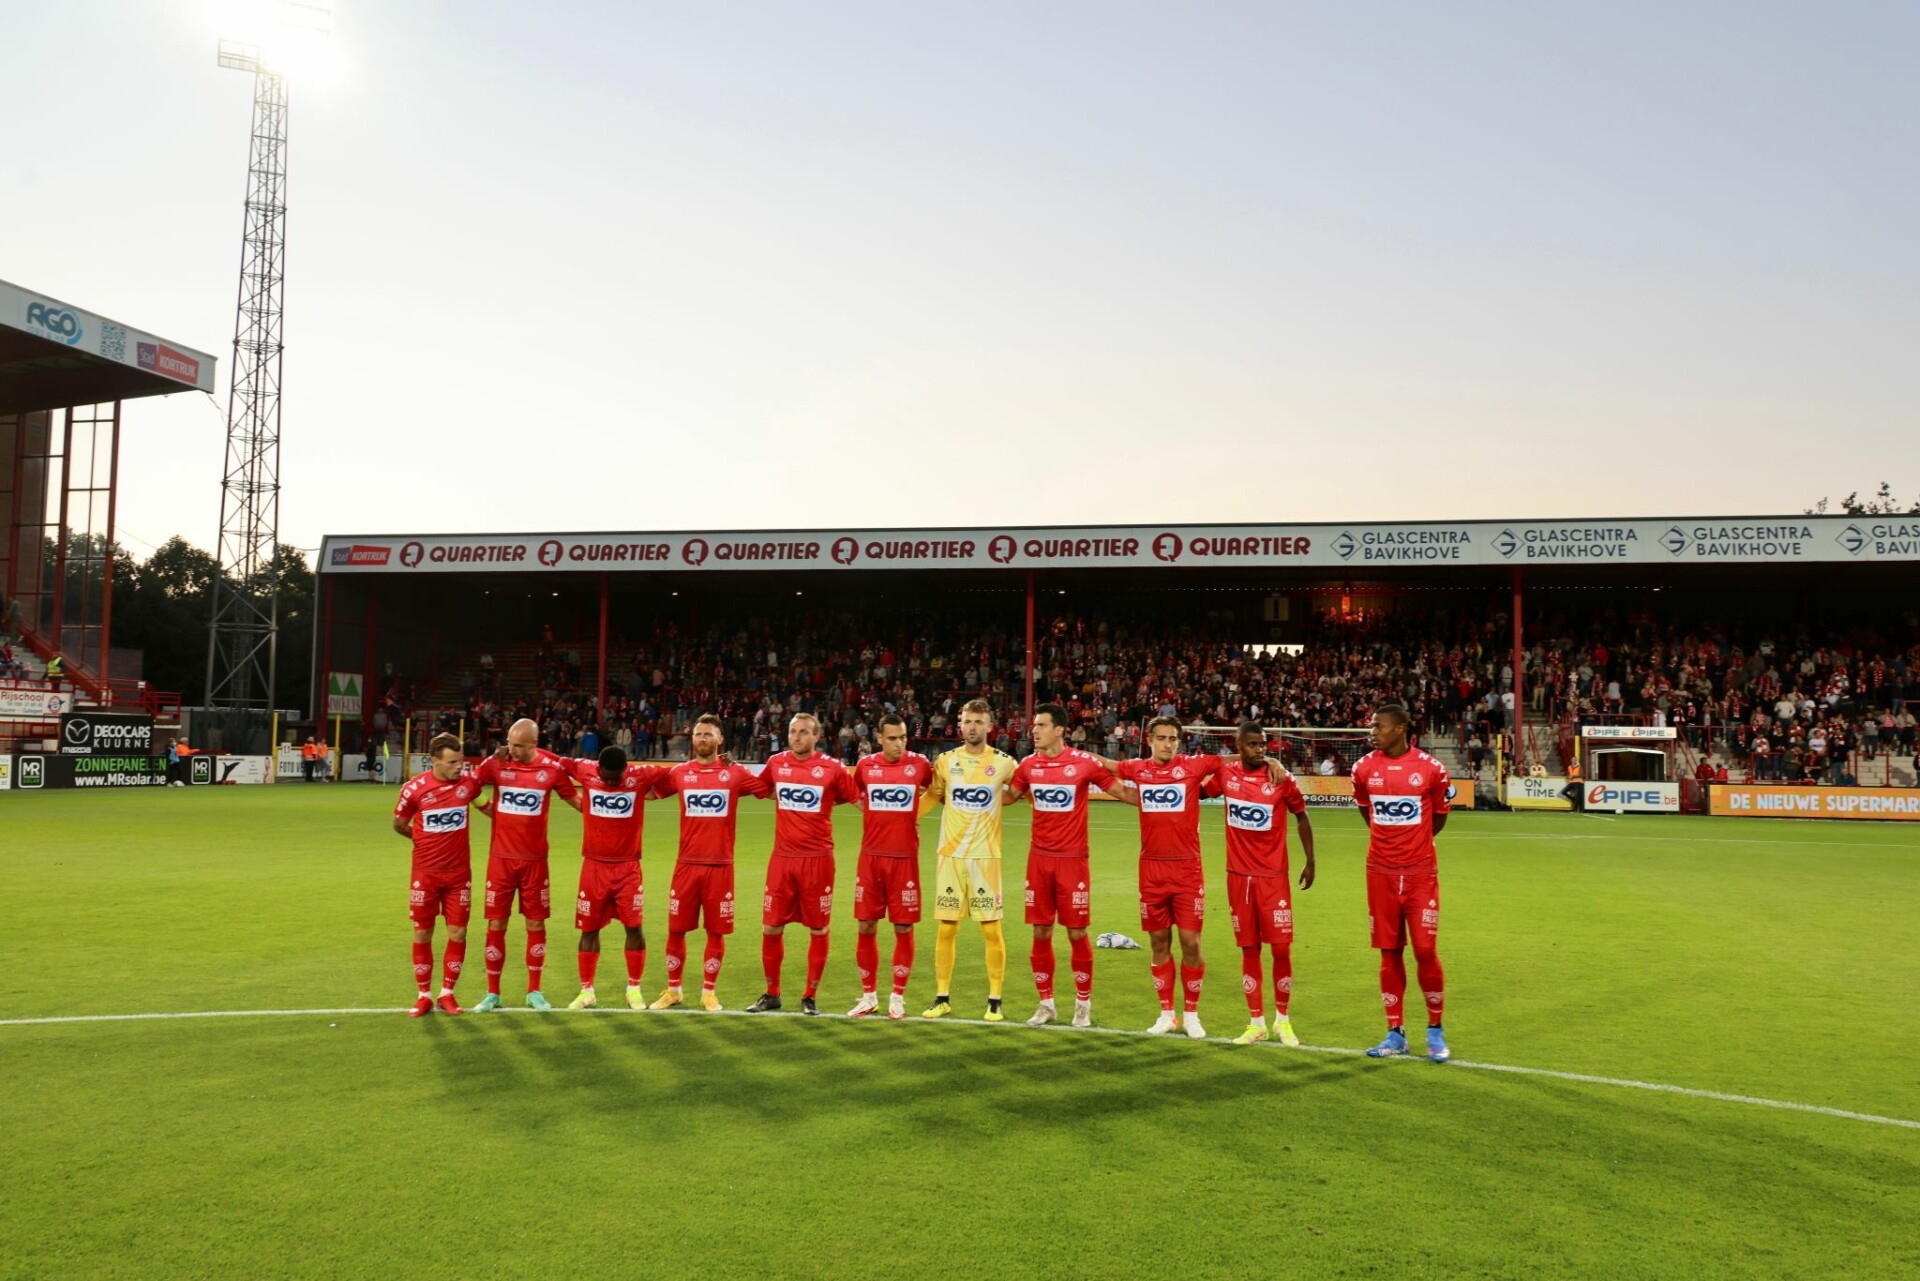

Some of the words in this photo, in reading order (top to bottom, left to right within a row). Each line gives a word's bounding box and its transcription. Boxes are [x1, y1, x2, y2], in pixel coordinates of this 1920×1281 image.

[27, 302, 77, 337] AGO
[1362, 531, 1470, 545] GLASCENTRA
[1524, 529, 1638, 542] GLASCENTRA
[1694, 526, 1813, 540] GLASCENTRA
[429, 545, 527, 562] QUARTIER
[569, 543, 671, 562] QUARTIER
[714, 542, 820, 560] QUARTIER
[865, 540, 975, 559] QUARTIER
[1023, 538, 1139, 558] QUARTIER
[1189, 536, 1311, 556] QUARTIER
[1364, 547, 1459, 559] BAVIKHOVE
[1526, 544, 1626, 557] BAVIKHOVE
[1697, 541, 1801, 555] BAVIKHOVE
[1, 691, 44, 701] Rijschool
[93, 725, 151, 738] DECOCARS
[93, 739, 150, 749] KUURNE
[23, 762, 40, 776] MR
[75, 758, 167, 772] ZONNEPANELEN
[194, 762, 208, 774] MR
[75, 773, 167, 786] www.MRsolar.be
[1524, 778, 1542, 788] ON
[502, 791, 539, 808] AGO
[687, 793, 723, 808] AGO
[779, 787, 817, 804] AGO
[871, 788, 908, 803] AGO
[952, 788, 989, 803] AGO
[1034, 788, 1069, 803] AGO
[1142, 788, 1179, 804] AGO
[1525, 789, 1555, 798] TIME
[593, 794, 629, 810] AGO
[1374, 800, 1416, 817] AGO
[1730, 793, 1751, 809] DE
[1757, 795, 1820, 811] NIEUWE
[1827, 796, 1920, 812] SUPERMAR
[427, 811, 464, 825] AGO
[1229, 803, 1266, 822] AGO
